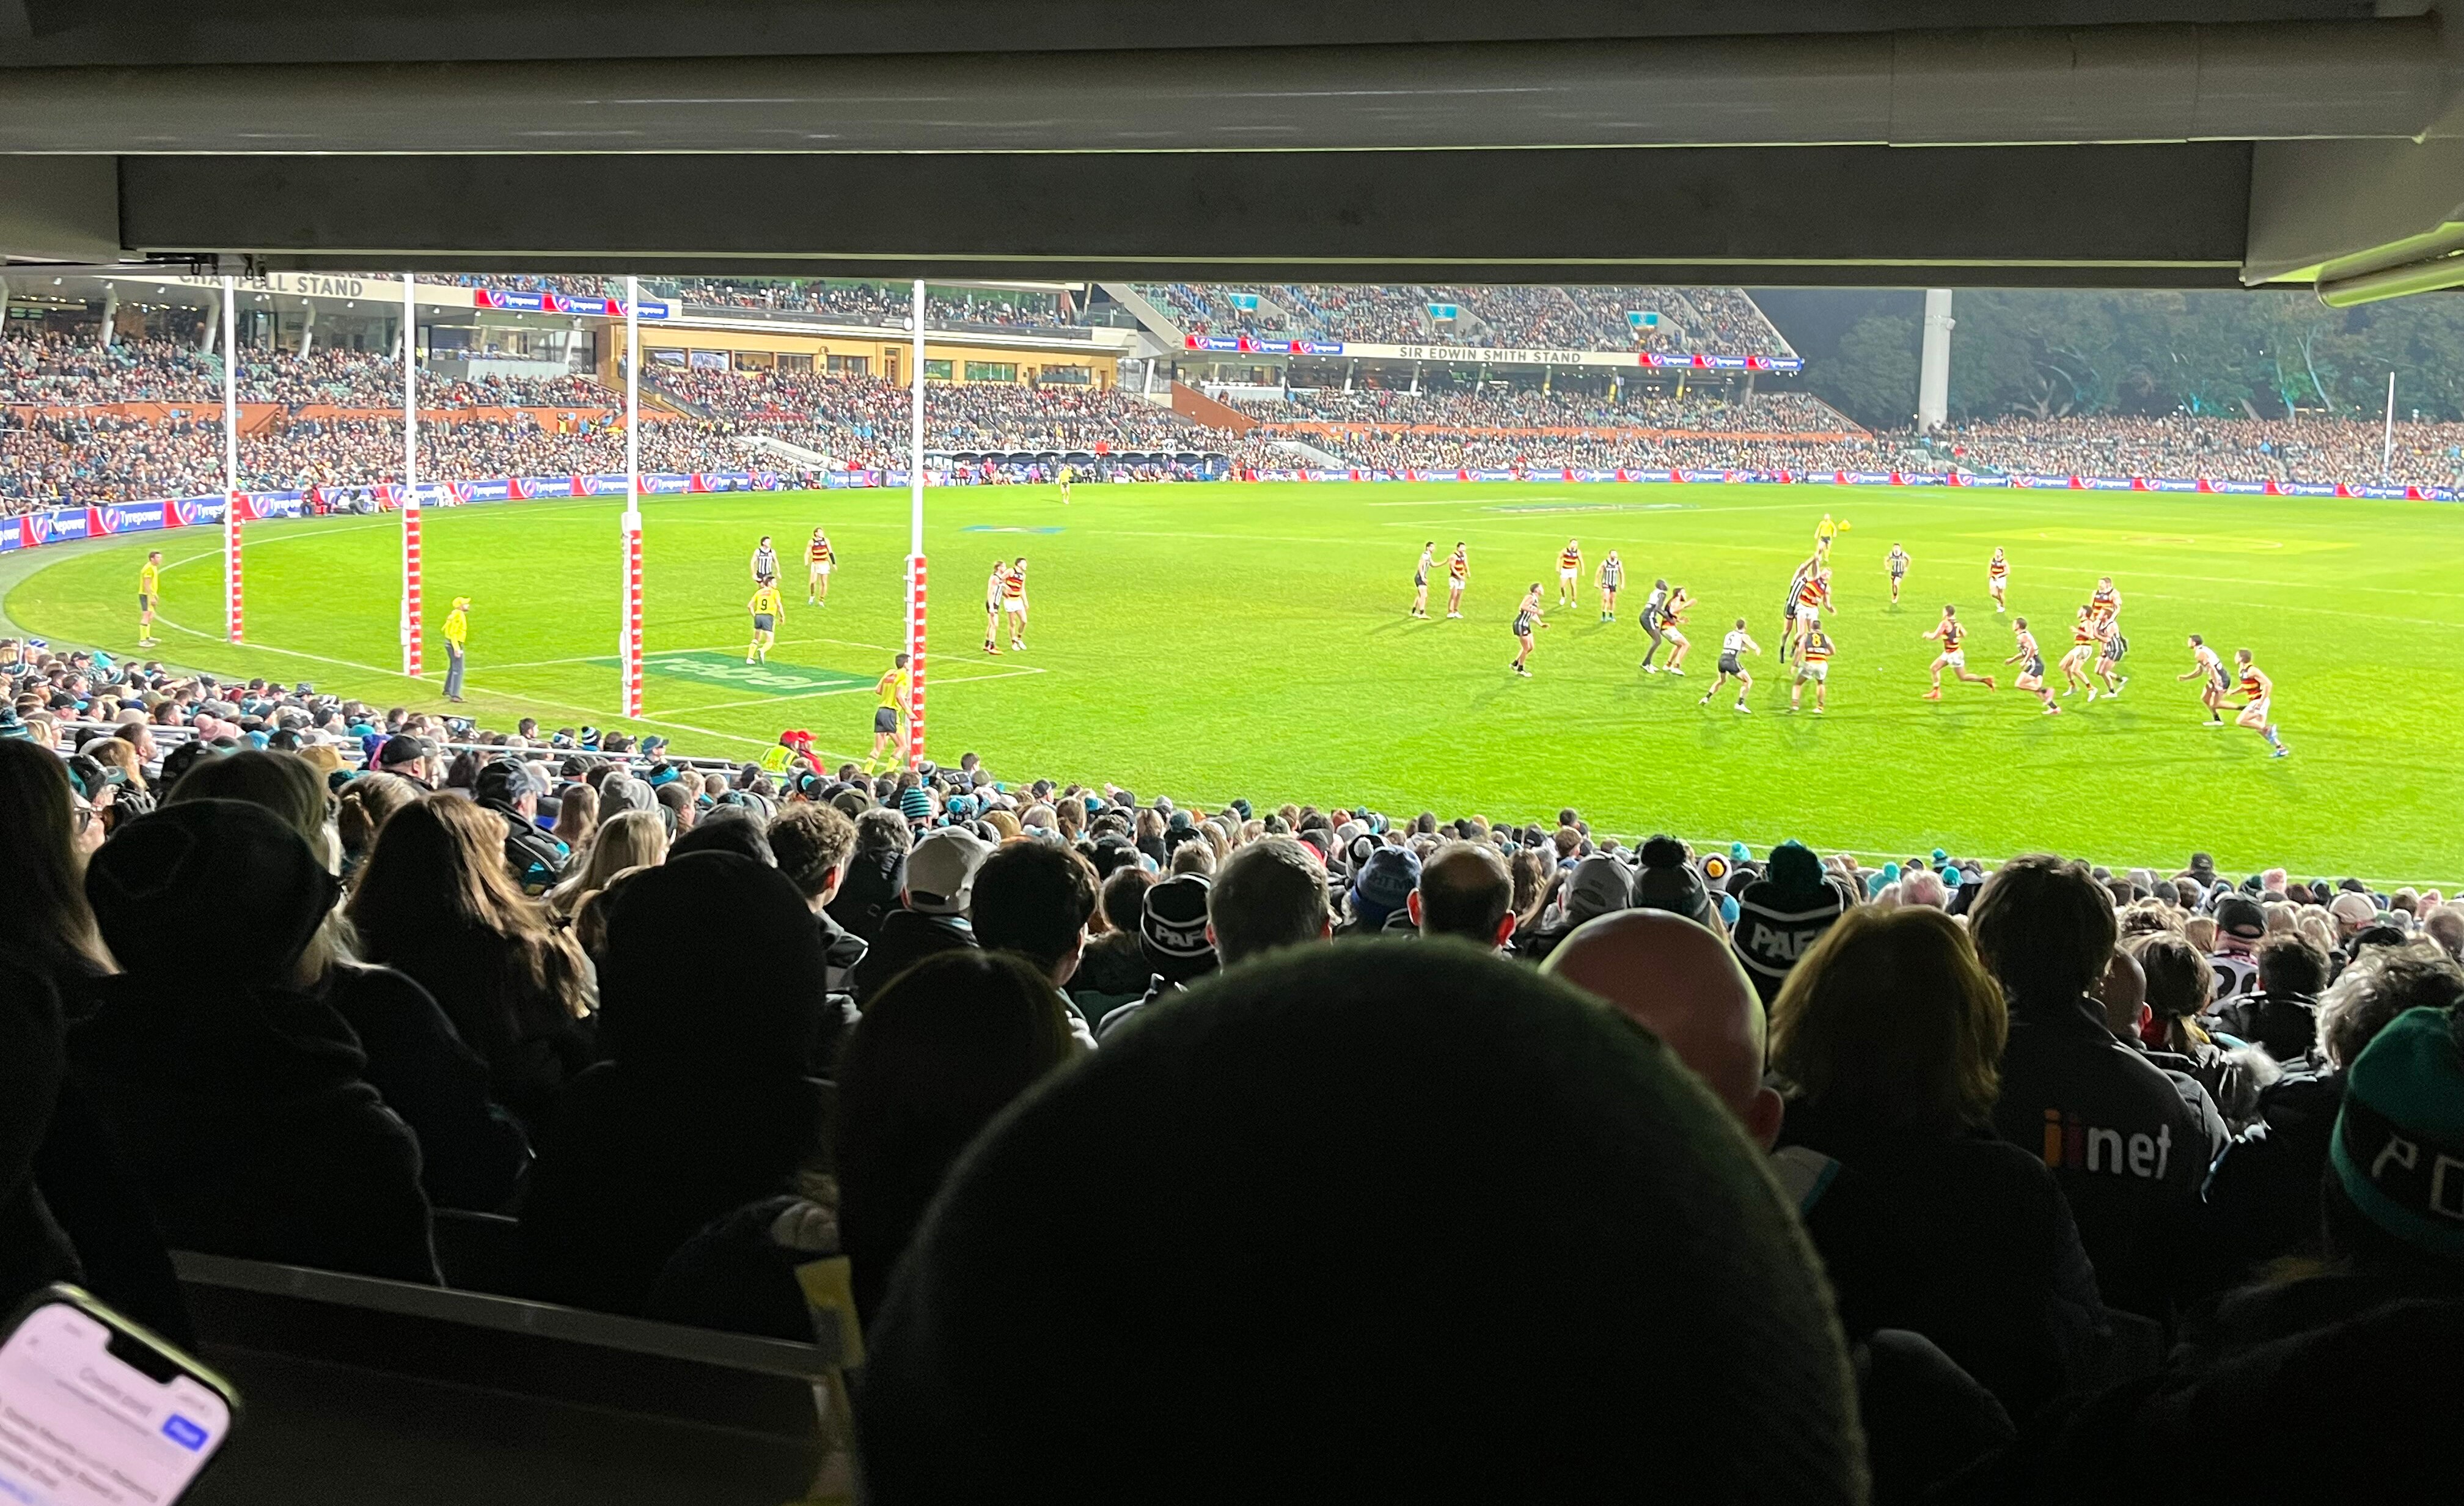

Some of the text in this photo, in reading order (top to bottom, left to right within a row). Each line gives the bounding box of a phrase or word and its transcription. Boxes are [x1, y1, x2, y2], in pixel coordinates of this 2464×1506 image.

[297, 276, 363, 297] STAND
[1399, 347, 1581, 363] SIR EDWIN SMITH STAND
[120, 510, 163, 527] Tyrepower
[760, 599, 768, 611] 9
[1811, 633, 1822, 647] 8
[1750, 922, 1824, 960] PAF
[2043, 1107, 2172, 1180] iinet
